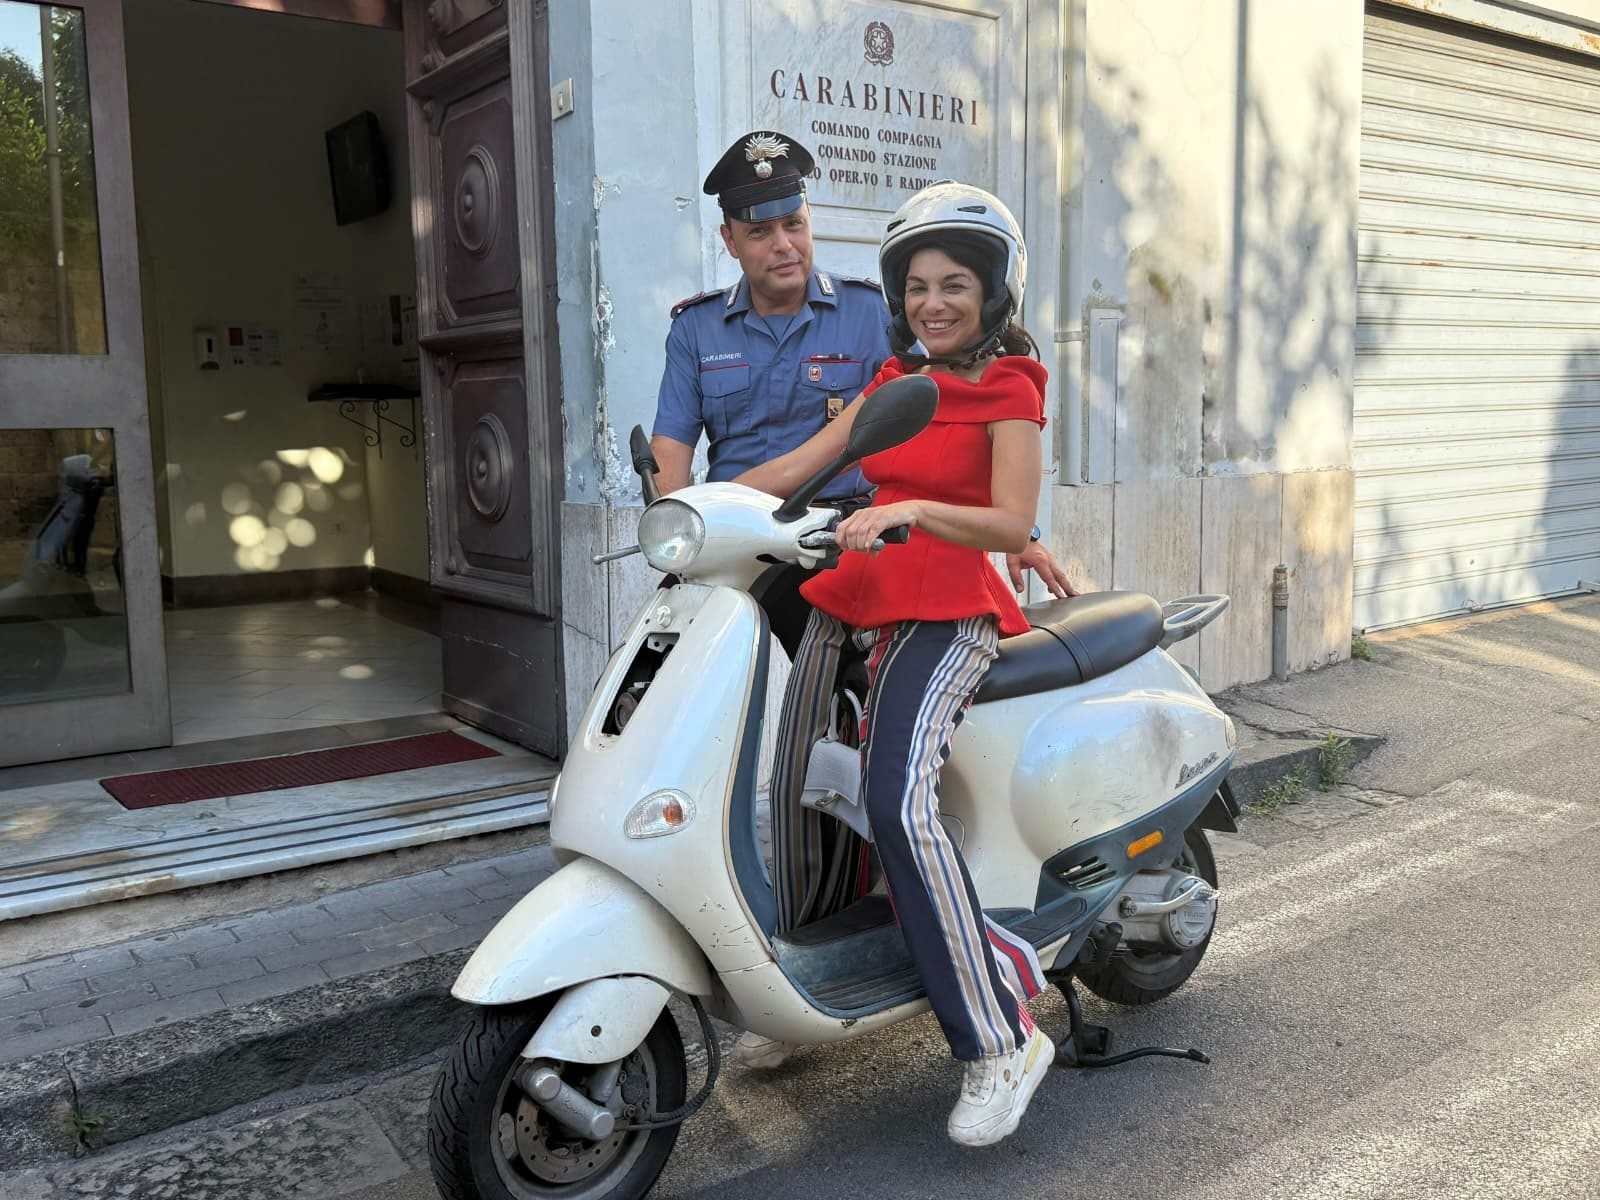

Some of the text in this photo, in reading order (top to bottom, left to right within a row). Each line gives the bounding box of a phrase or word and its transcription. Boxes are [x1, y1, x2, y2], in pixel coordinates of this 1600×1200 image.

[770, 69, 978, 126] CARABINIERI
[811, 120, 942, 149] COMANDO COMPAGNIA
[818, 144, 937, 171] COMANDO STAZIONE
[830, 169, 879, 186] OPER.VO
[886, 176, 893, 188] E
